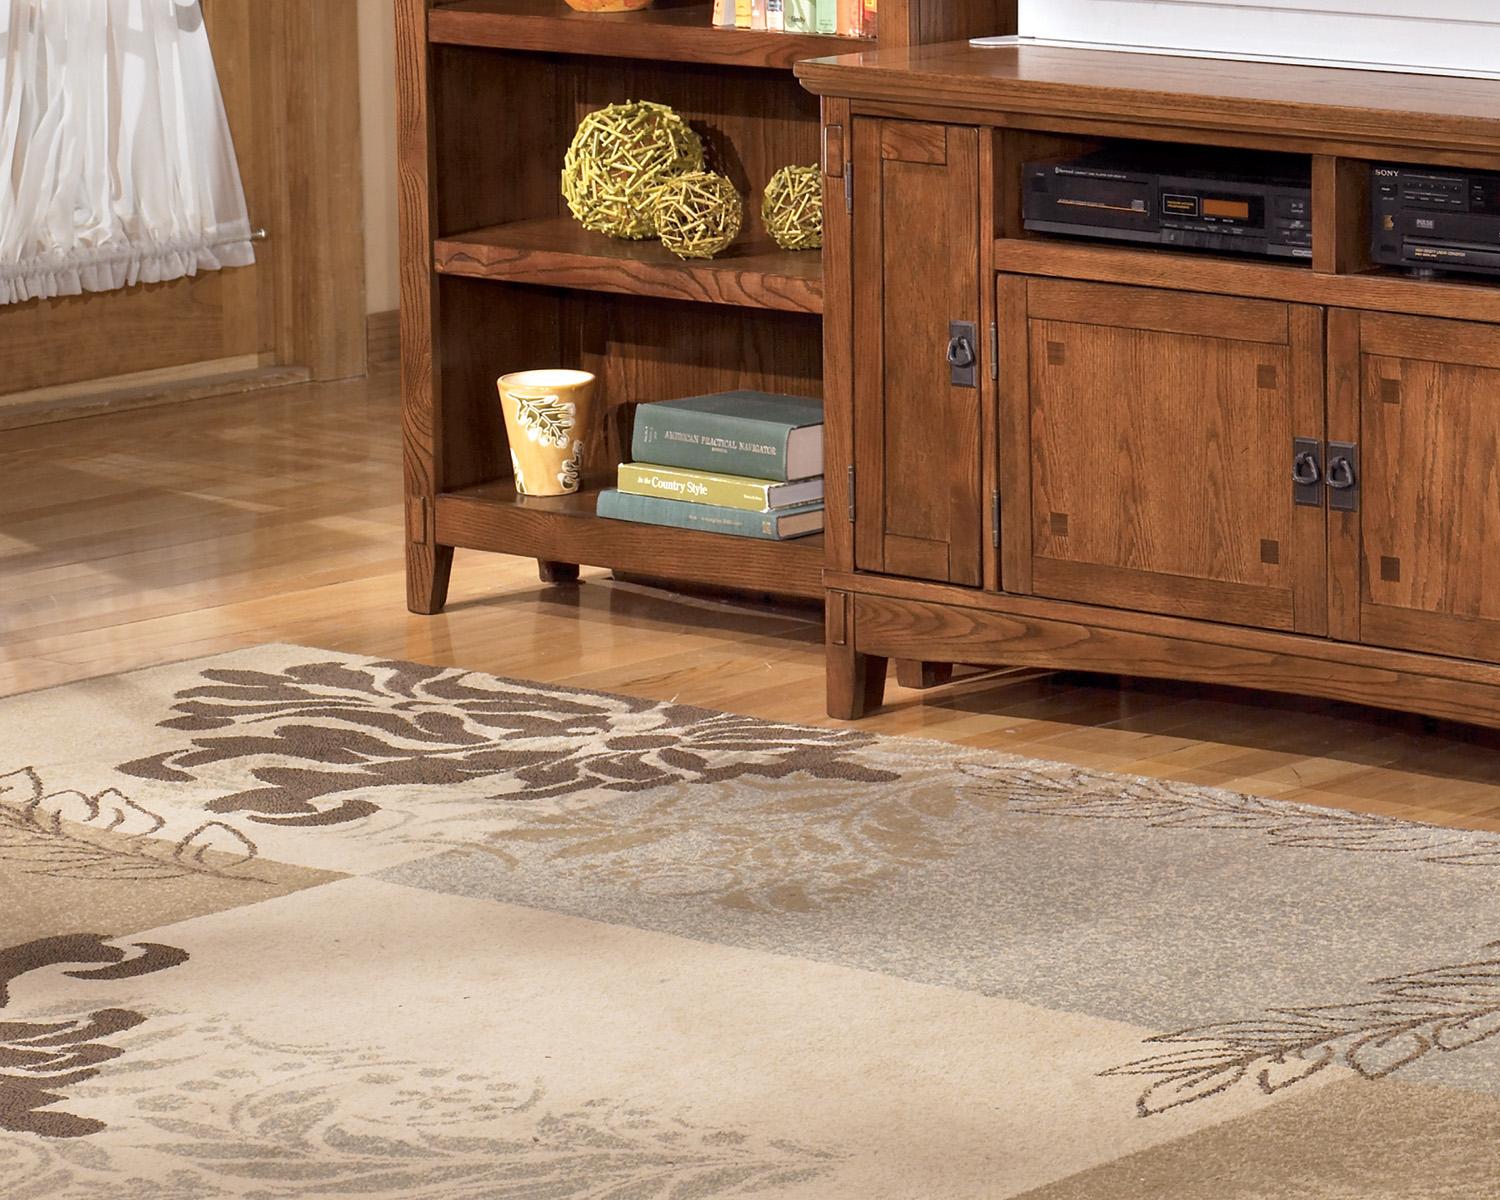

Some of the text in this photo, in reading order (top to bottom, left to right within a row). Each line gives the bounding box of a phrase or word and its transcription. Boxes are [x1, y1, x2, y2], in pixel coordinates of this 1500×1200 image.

[1375, 169, 1399, 177] SONY
[664, 430, 699, 445] AMERICAN
[701, 436, 738, 450] PRACTICAL
[739, 441, 776, 456] NAVIGATOR
[652, 477, 685, 494] Country
[687, 481, 708, 496] Style
